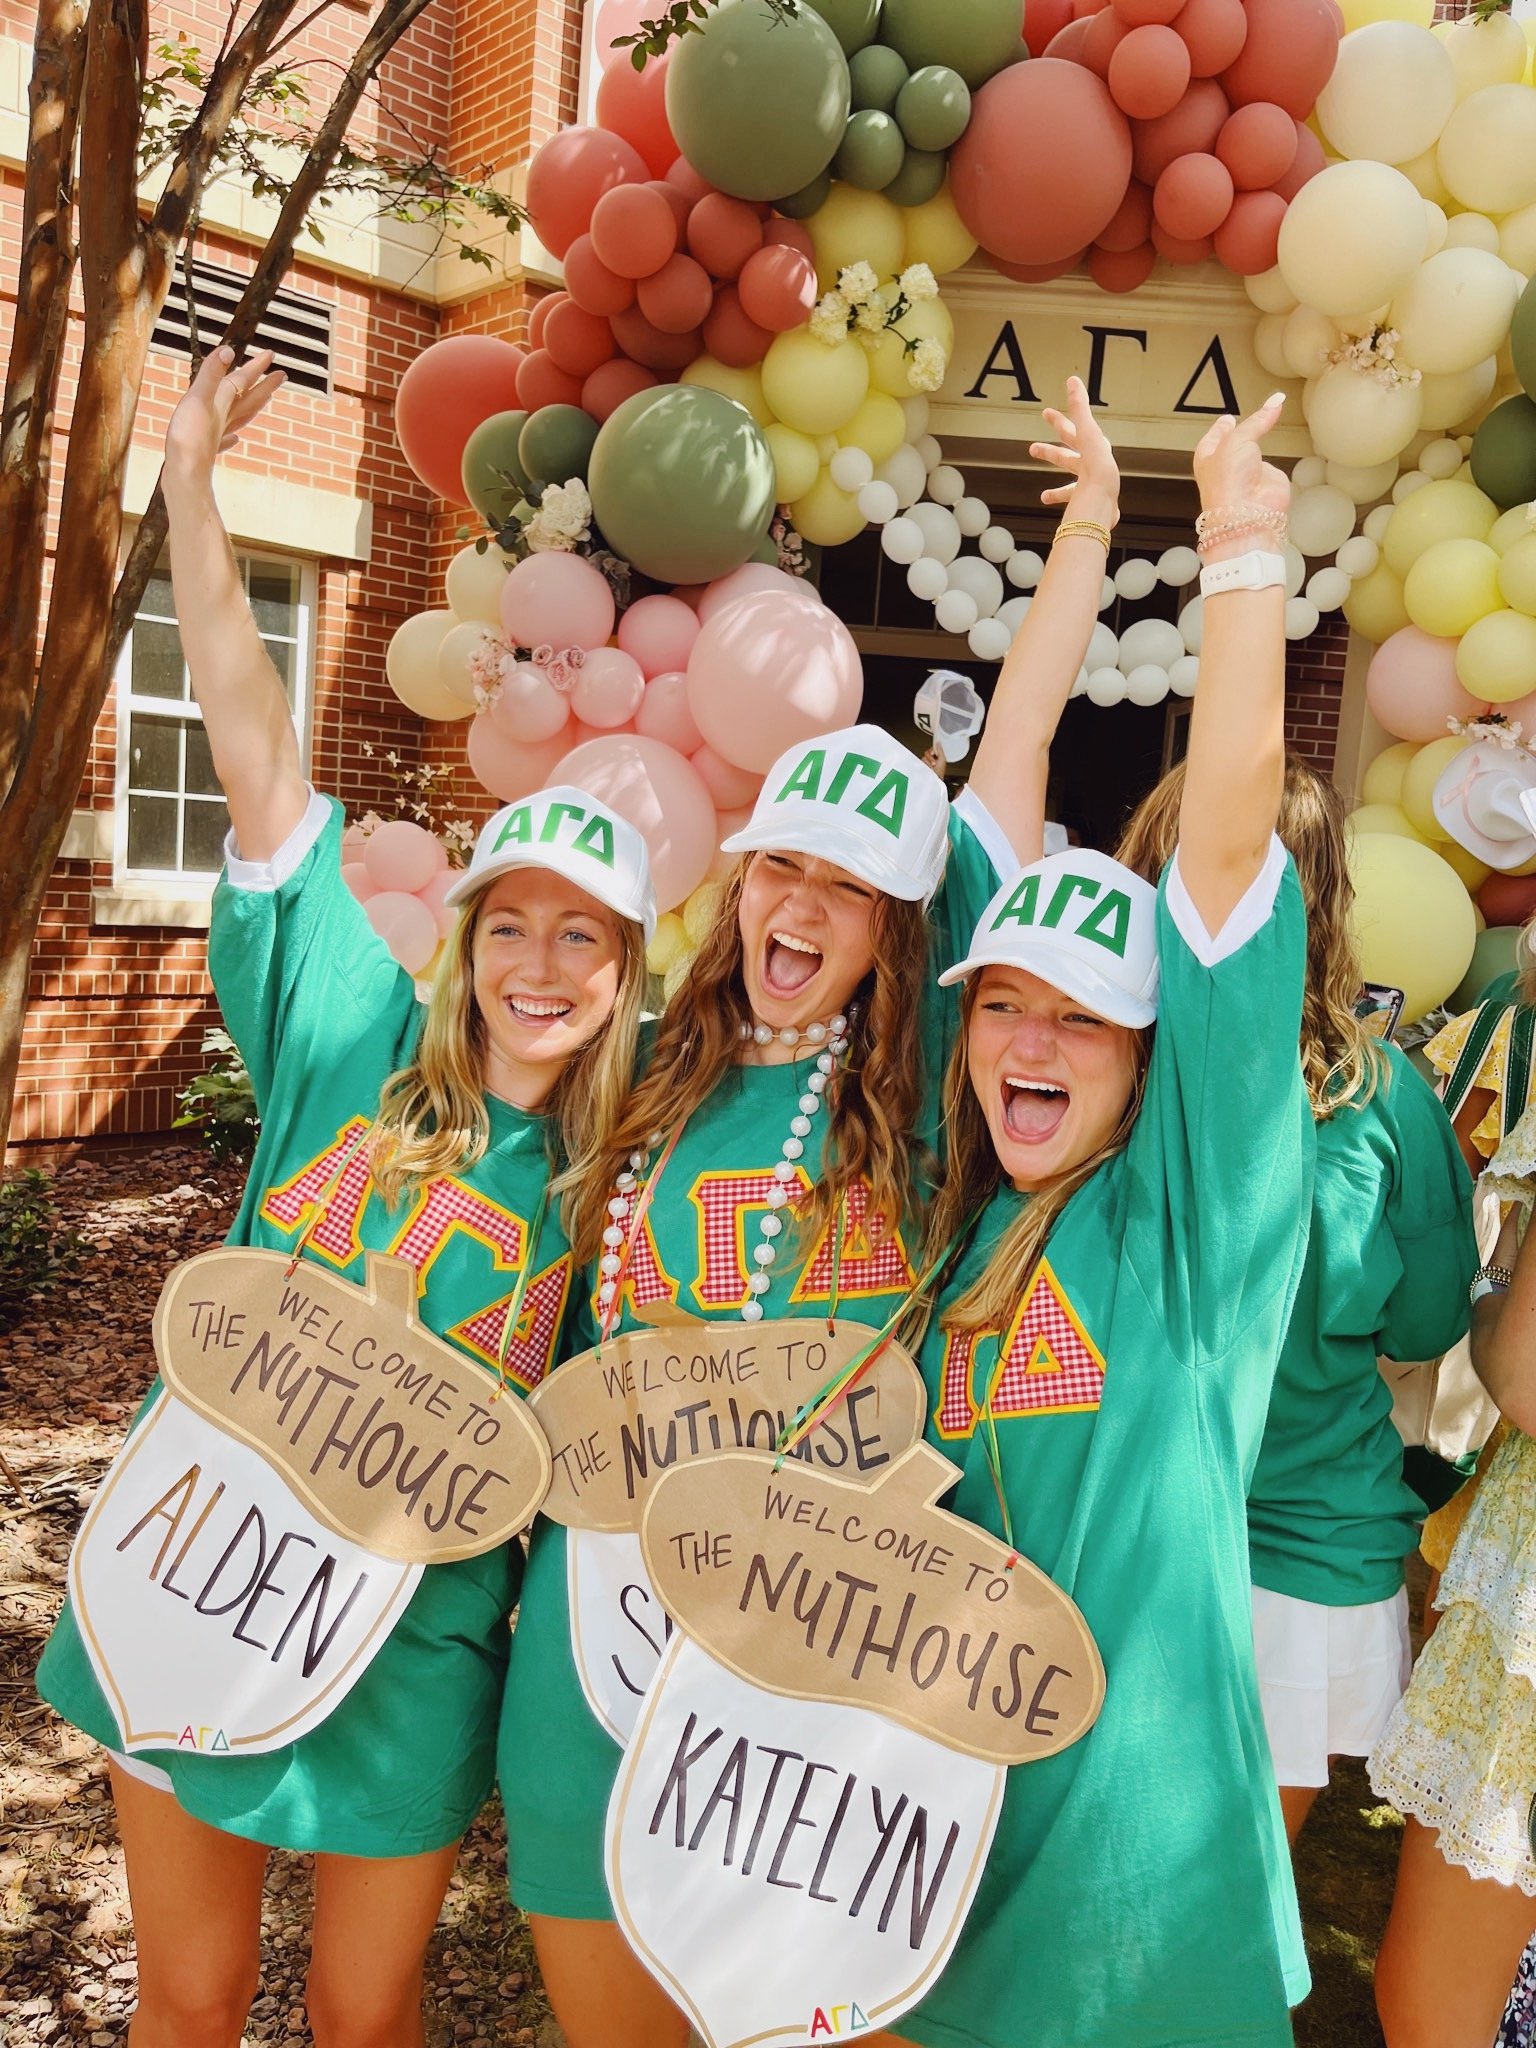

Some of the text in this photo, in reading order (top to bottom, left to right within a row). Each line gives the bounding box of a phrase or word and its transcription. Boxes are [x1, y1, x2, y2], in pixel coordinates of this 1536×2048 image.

[963, 320, 1241, 416] ΑΓΔ
[490, 802, 615, 870] ΑΓΔ
[774, 748, 908, 839] ΑΓΔ
[989, 873, 1132, 959] ΑΓΔ
[278, 1286, 501, 1445] WELCOME TO
[602, 1341, 827, 1399] WELCOME TO
[188, 1301, 510, 1536] THE NUTHOUSE
[552, 1431, 612, 1497] THE
[116, 1463, 369, 1679] ALDEN
[764, 1485, 1009, 1602] WELCOME TO
[669, 1530, 1073, 1736] THE NUTHOUSE
[178, 1725, 230, 1751] ΑΓΔ
[649, 1712, 960, 1951] KATELYN
[810, 2002, 869, 2038] ΑΓΔ
